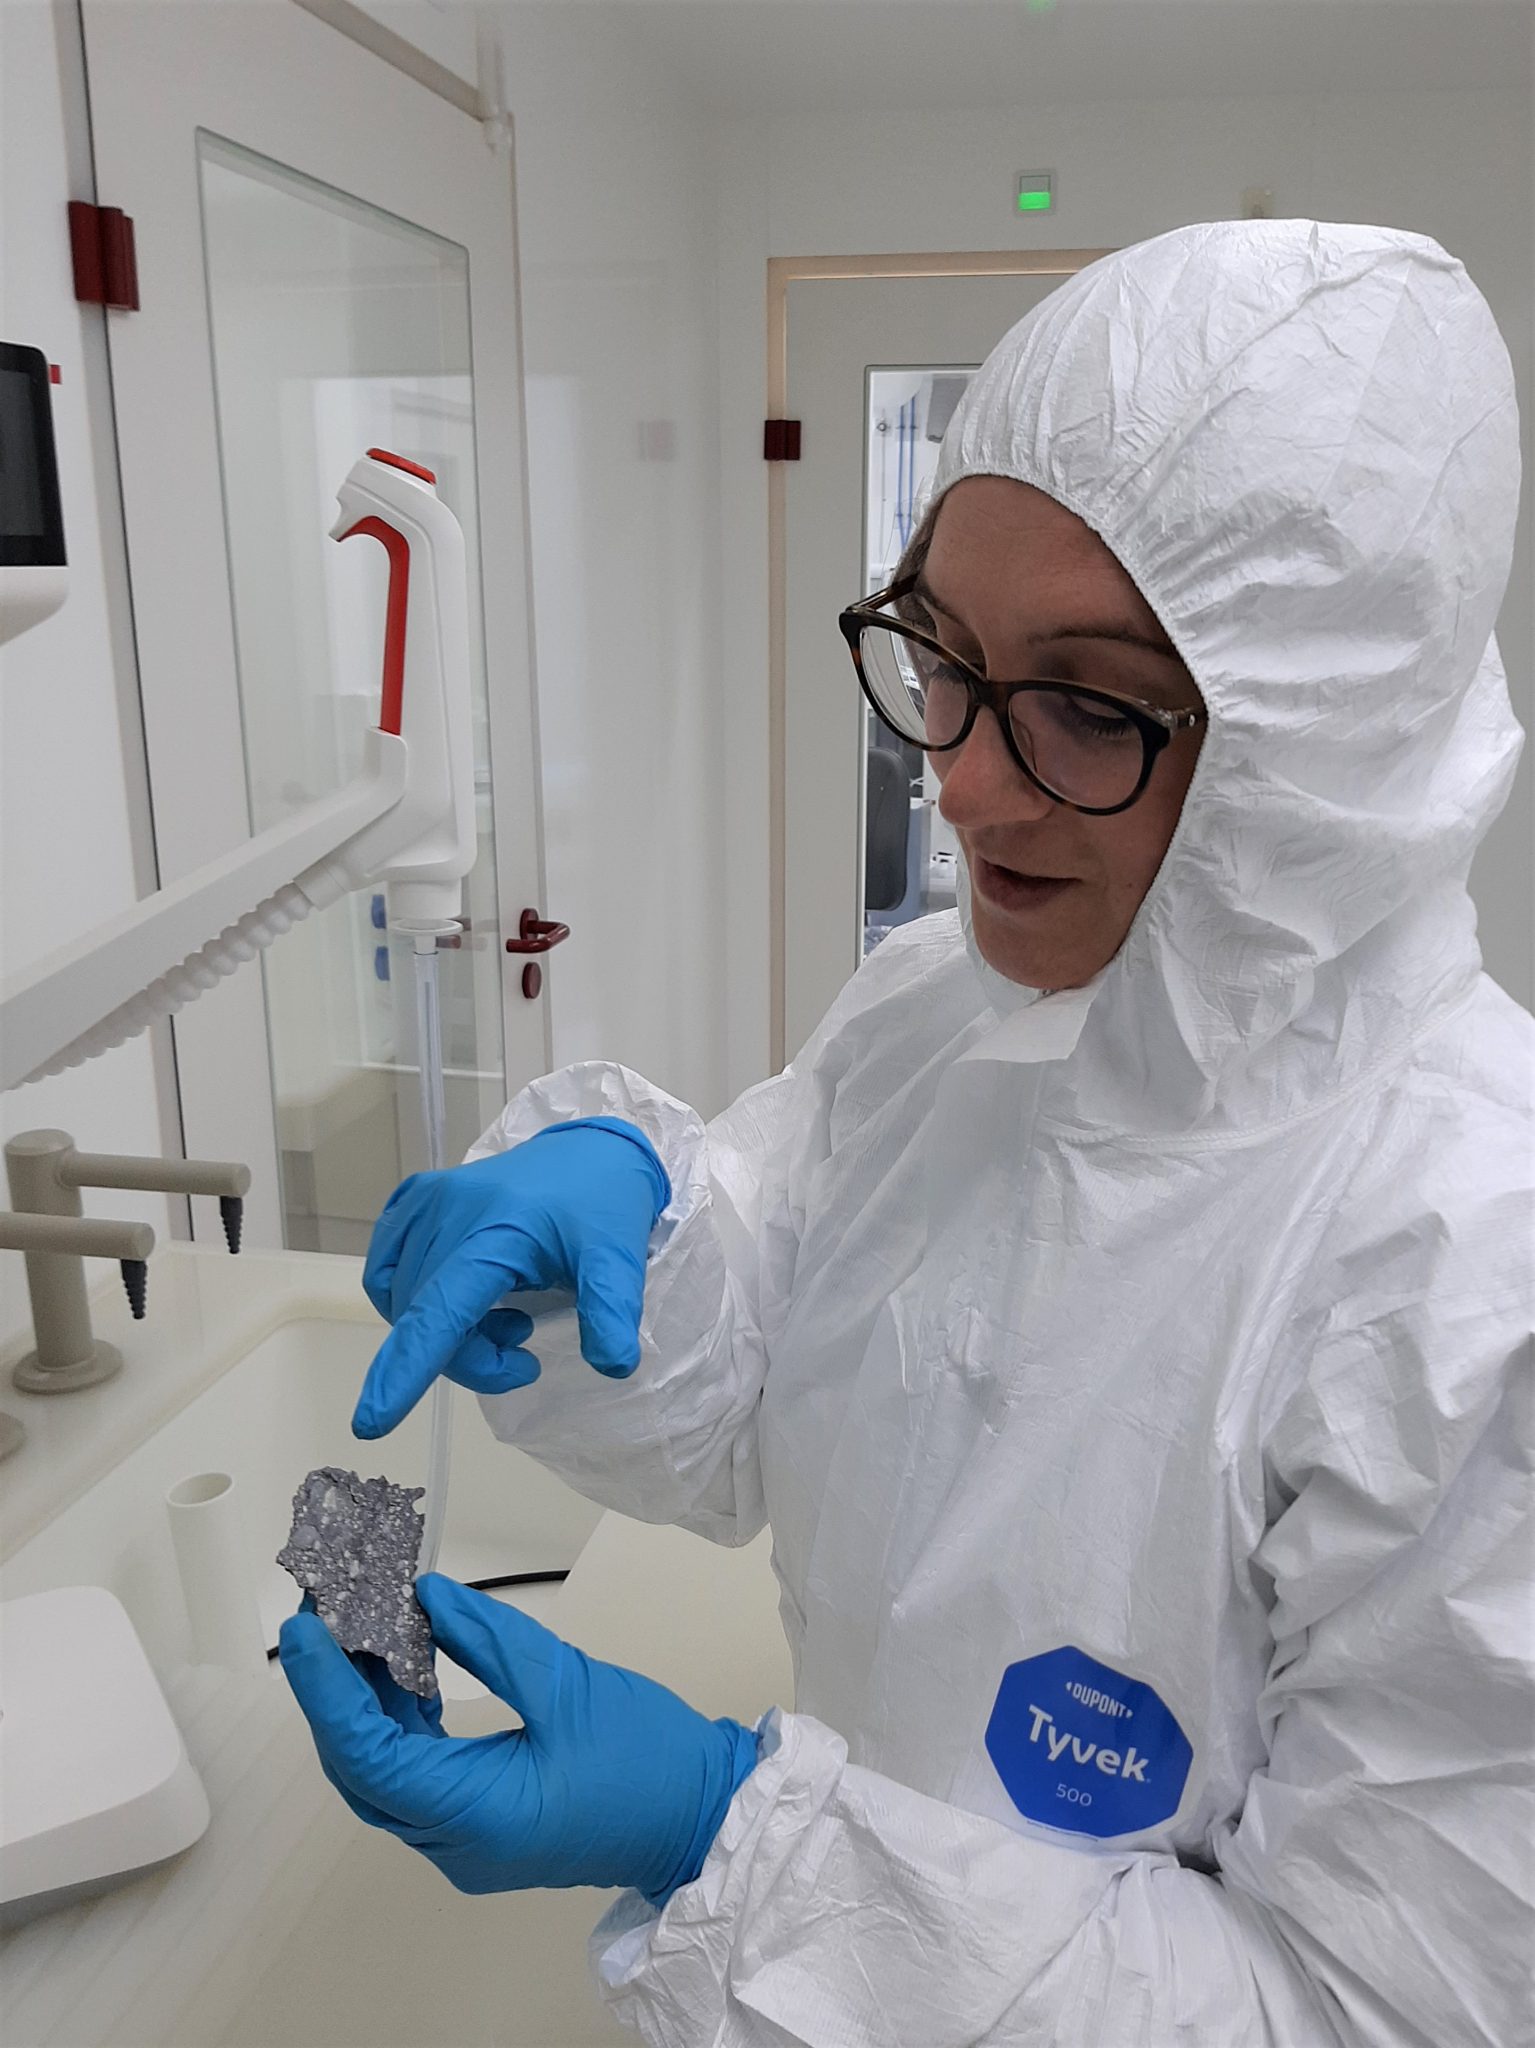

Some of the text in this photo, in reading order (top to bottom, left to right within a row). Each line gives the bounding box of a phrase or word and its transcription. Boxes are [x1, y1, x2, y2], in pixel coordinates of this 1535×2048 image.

[1072, 1683, 1127, 1718] DUPONT
[1029, 1705, 1149, 1782] Tyvek
[1056, 1784, 1092, 1807] 500
